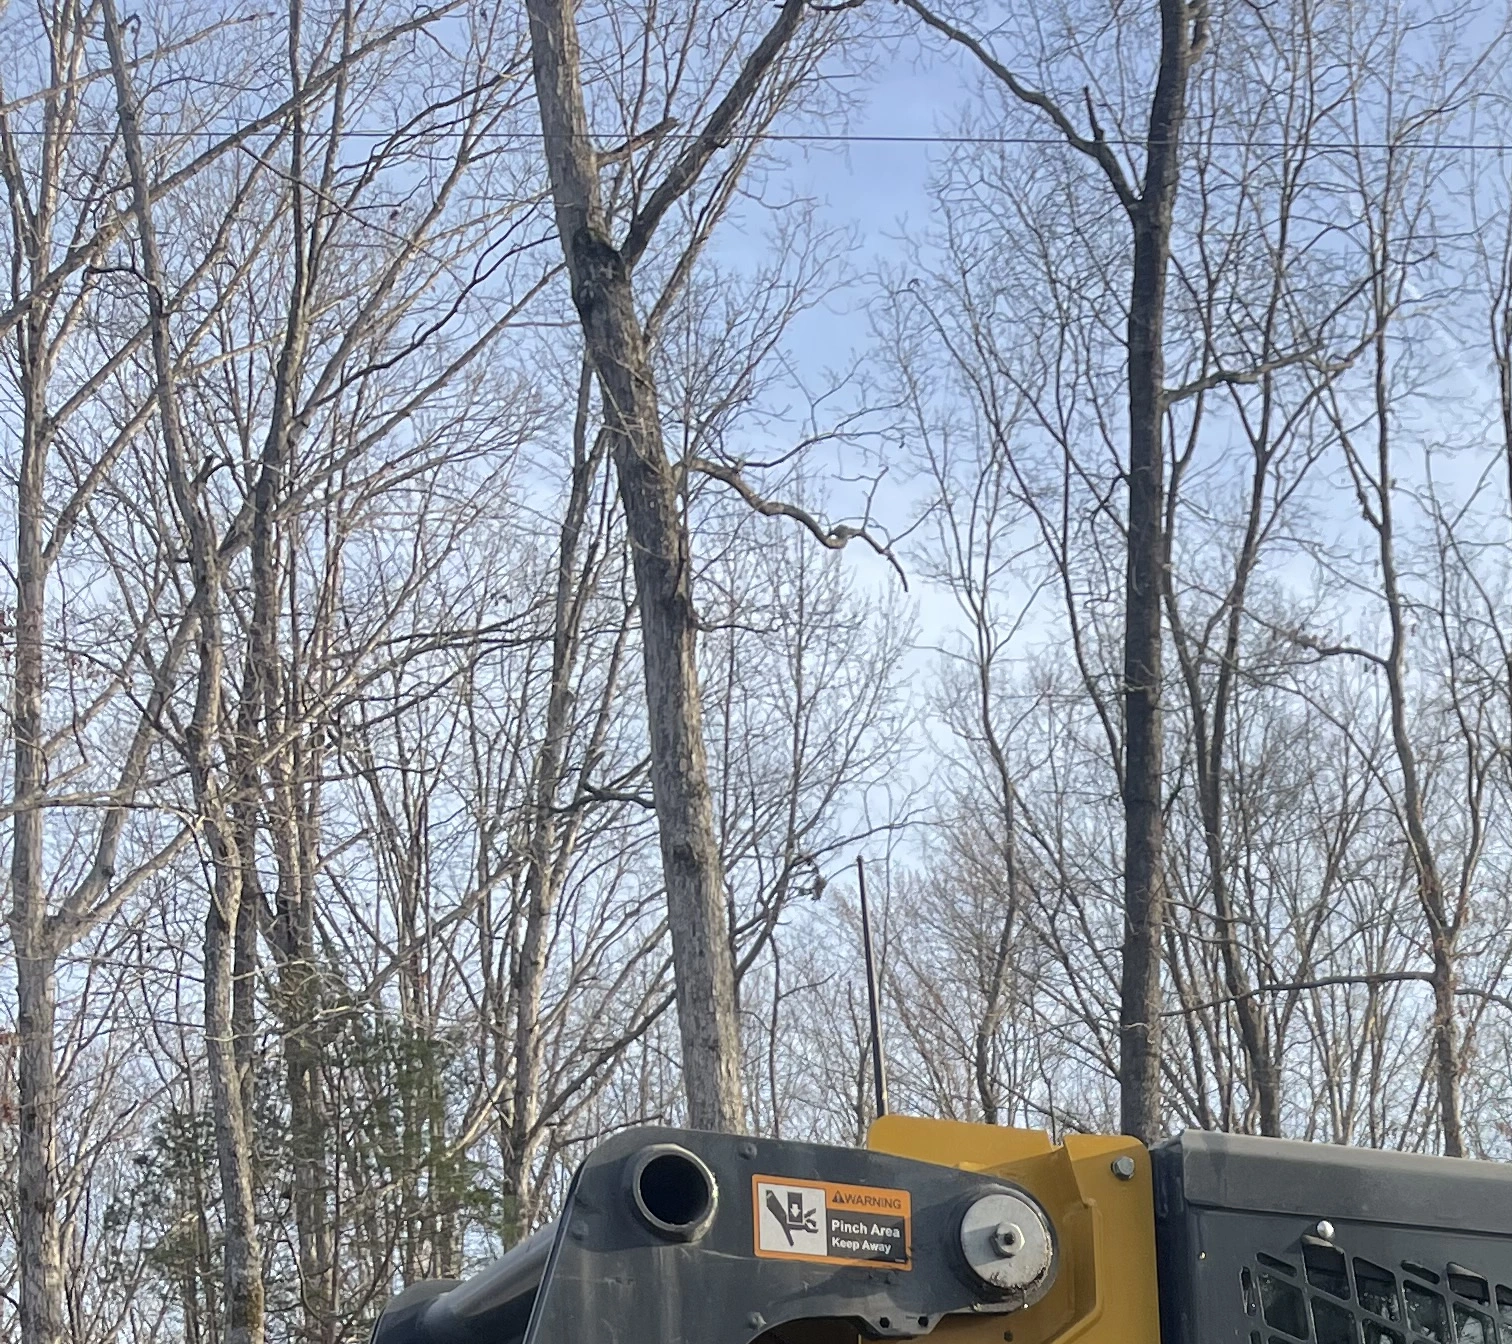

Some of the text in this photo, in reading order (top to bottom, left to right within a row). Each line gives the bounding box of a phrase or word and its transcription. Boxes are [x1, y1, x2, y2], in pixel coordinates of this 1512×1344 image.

[845, 1193, 902, 1209] WARNING
[831, 1219, 901, 1238] Pinch Area
[831, 1236, 892, 1255] Keep Away
